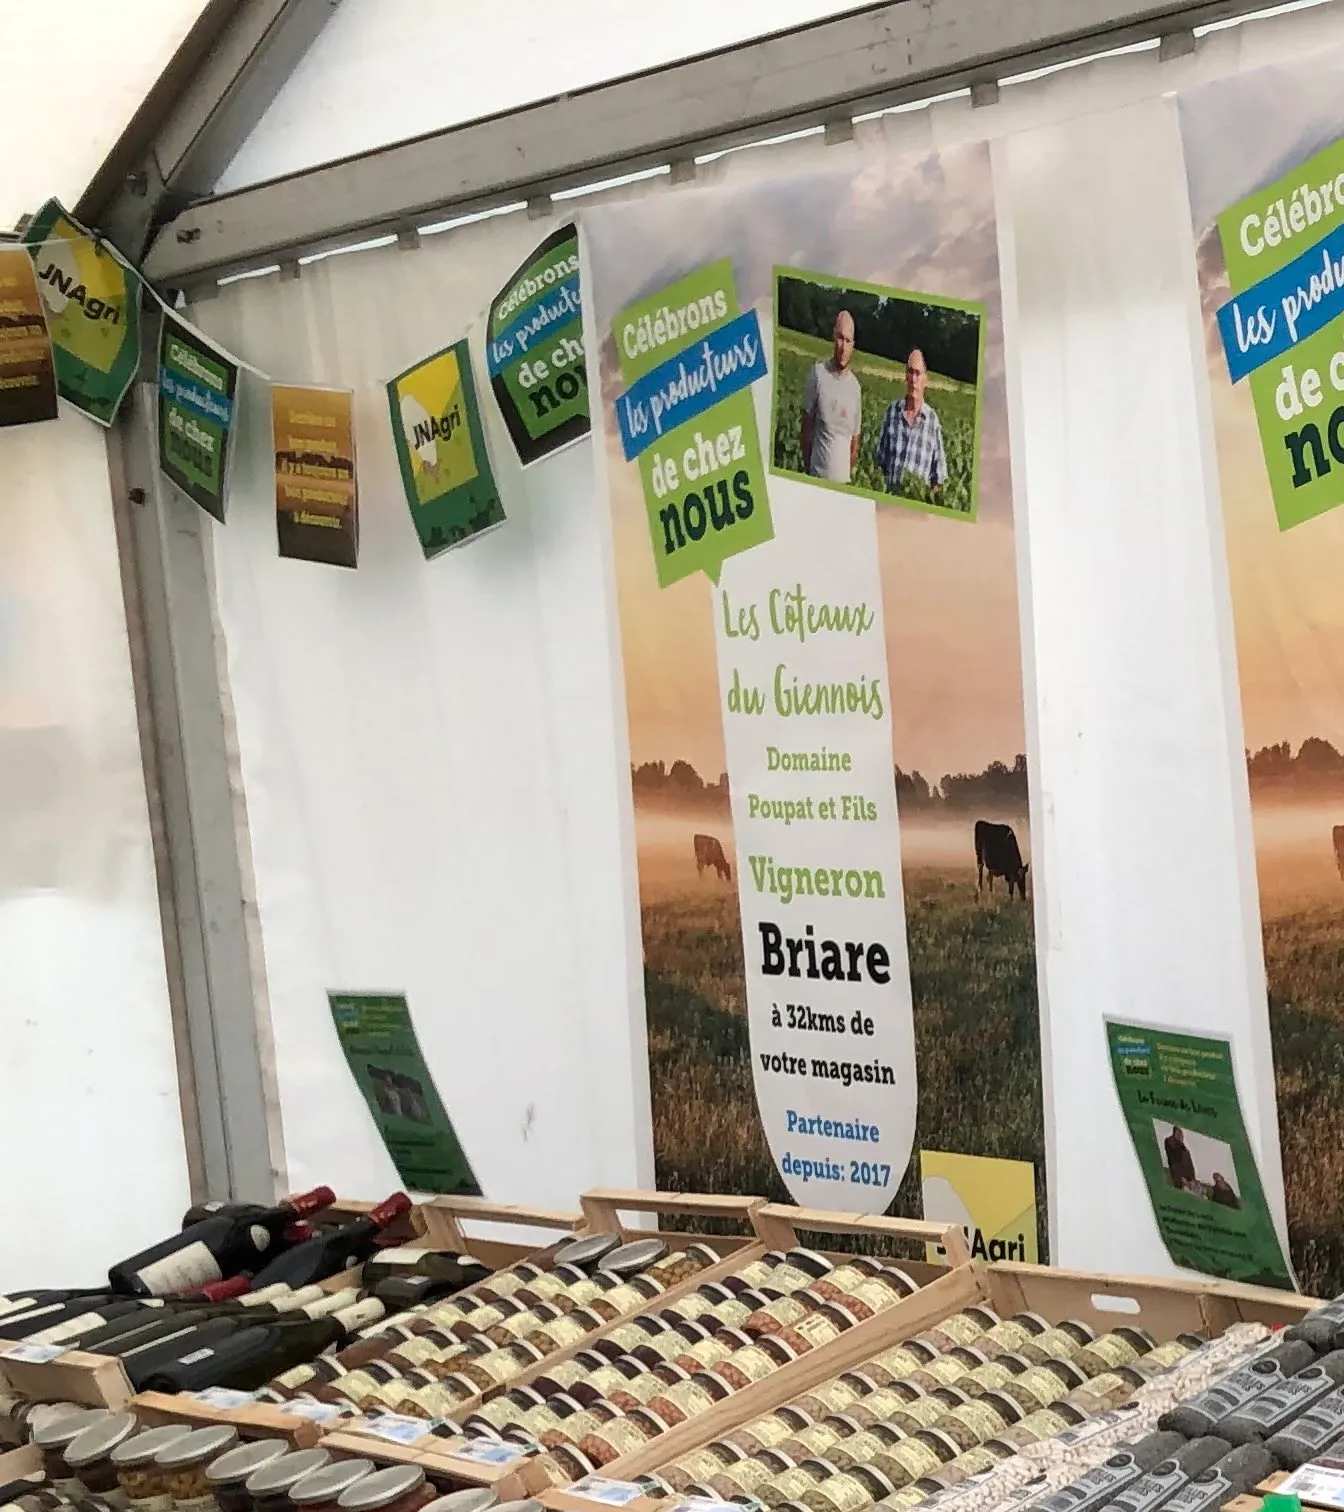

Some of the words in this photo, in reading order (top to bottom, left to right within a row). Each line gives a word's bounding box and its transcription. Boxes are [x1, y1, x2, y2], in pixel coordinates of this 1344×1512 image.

[39, 264, 121, 324] JNAgri
[623, 288, 727, 359] Célébrons
[1233, 303, 1276, 353] les
[518, 360, 549, 388] de
[626, 395, 648, 438] les
[650, 332, 758, 433] producteurs
[1276, 365, 1323, 419] de
[412, 405, 461, 451] JNAgri
[651, 452, 679, 498] de
[682, 425, 746, 483] chez
[659, 470, 755, 555] nous
[722, 590, 760, 641] Les
[769, 584, 874, 642] Côteaux
[727, 668, 765, 715] du
[774, 663, 884, 720] Giennois
[767, 746, 851, 772] Domaine
[748, 794, 814, 825] Poupat
[819, 798, 836, 819] et
[841, 796, 877, 821] Fils
[748, 856, 886, 904] Vigneron
[759, 922, 891, 984] Briare
[772, 1003, 782, 1027] à
[786, 1004, 845, 1034] 32kms
[850, 1010, 874, 1036] de
[760, 1053, 807, 1077] votre
[811, 1058, 896, 1087] magasin
[786, 1110, 880, 1143] Partenaire
[782, 1152, 845, 1184] depuis:
[850, 1161, 891, 1188] 2017
